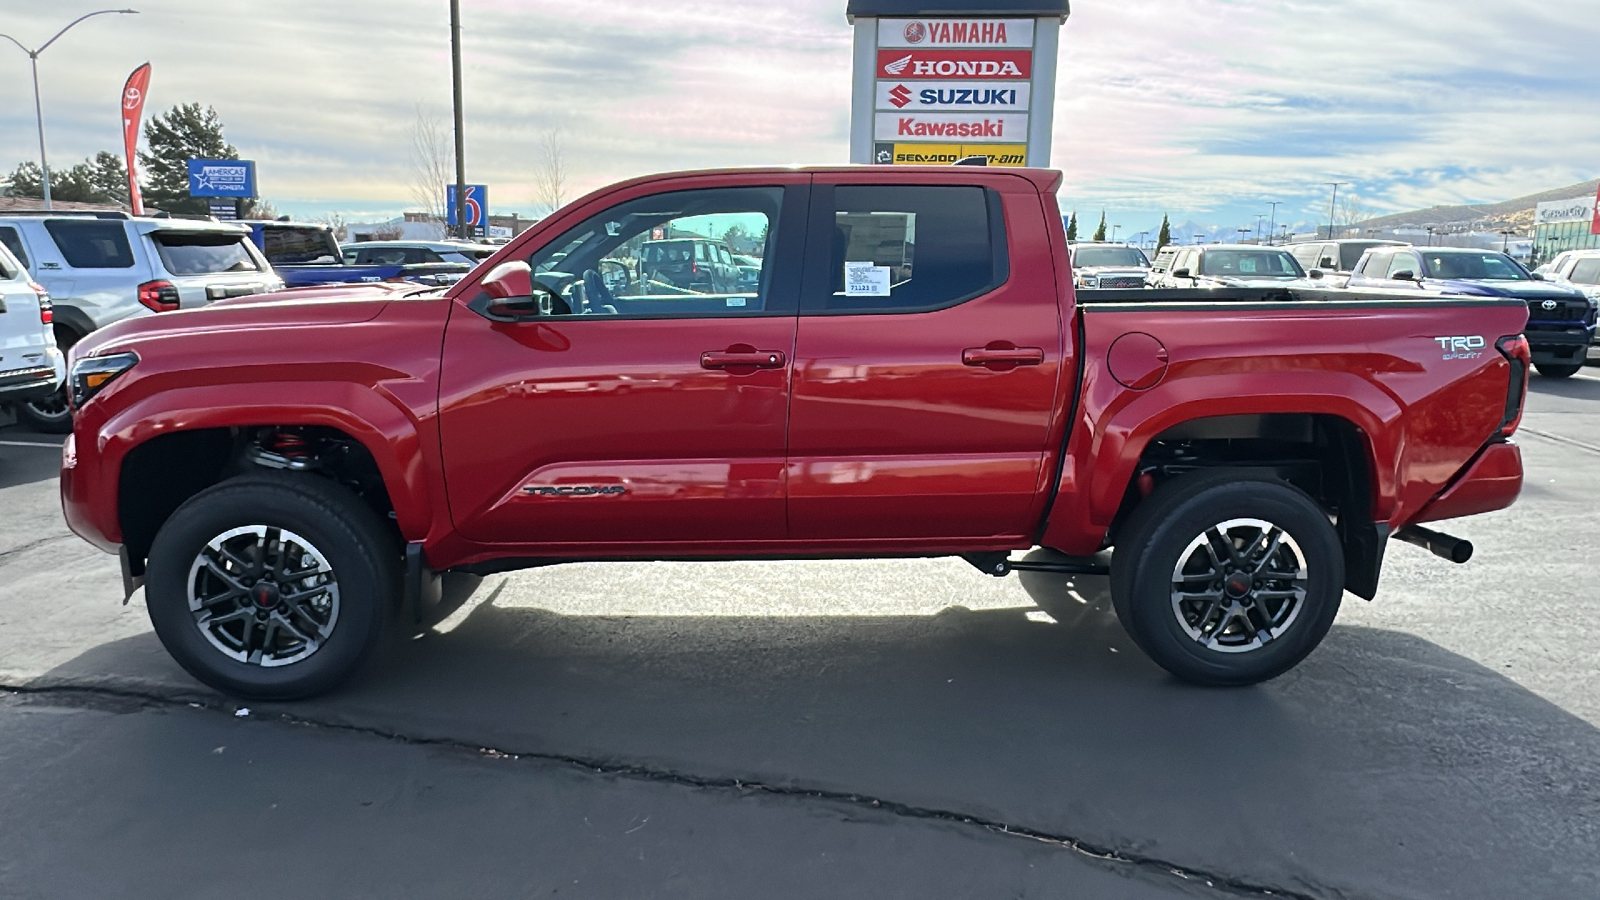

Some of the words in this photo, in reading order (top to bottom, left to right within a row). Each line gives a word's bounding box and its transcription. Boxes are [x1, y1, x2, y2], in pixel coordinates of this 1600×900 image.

[928, 22, 1007, 43] YAMAHA
[913, 60, 1022, 76] HONDA
[919, 89, 1016, 105] SUZUKI
[898, 118, 1004, 137] Kawasaki
[208, 168, 244, 176] AMERICAS
[1434, 335, 1487, 352] TRD
[1442, 352, 1482, 360] SPORT
[523, 485, 626, 496] TACOMA
